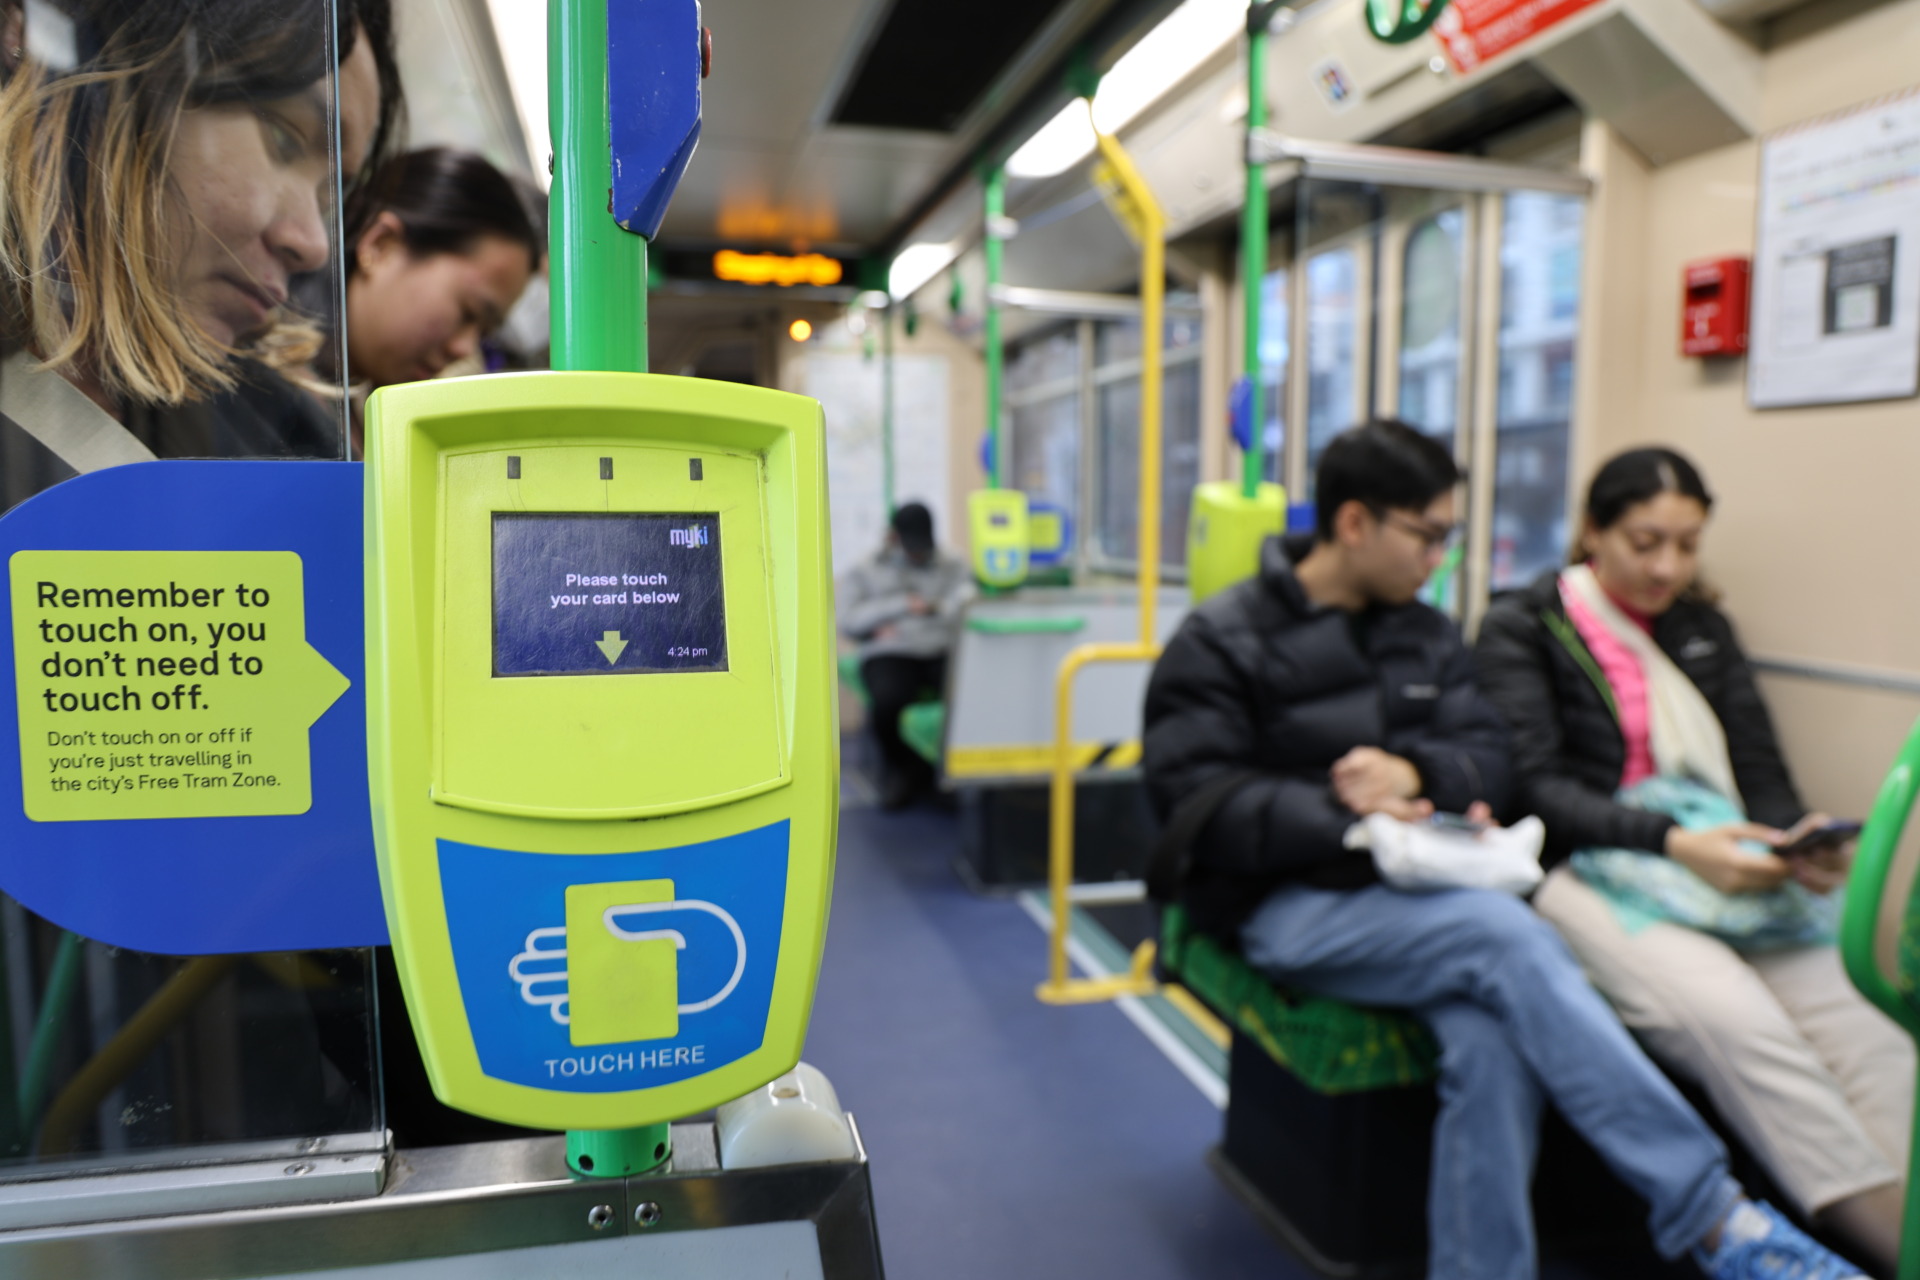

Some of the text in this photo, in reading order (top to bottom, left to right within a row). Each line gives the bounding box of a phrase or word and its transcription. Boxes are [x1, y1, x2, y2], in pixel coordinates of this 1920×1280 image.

[670, 524, 708, 548] myki
[566, 573, 667, 587] Please touch
[37, 581, 271, 608] Remember to
[551, 591, 680, 608] your card below
[39, 616, 266, 649] touch on, you
[41, 650, 264, 678] don’t need to
[667, 647, 708, 658] 4:24 pm
[43, 684, 209, 713] touch off.
[47, 728, 253, 747] Don’t touch on or off if
[49, 751, 252, 773] you’re just travelling in
[50, 772, 282, 794] the city’s Free Tram Zone.
[544, 1045, 706, 1079] TOUCH HERE
